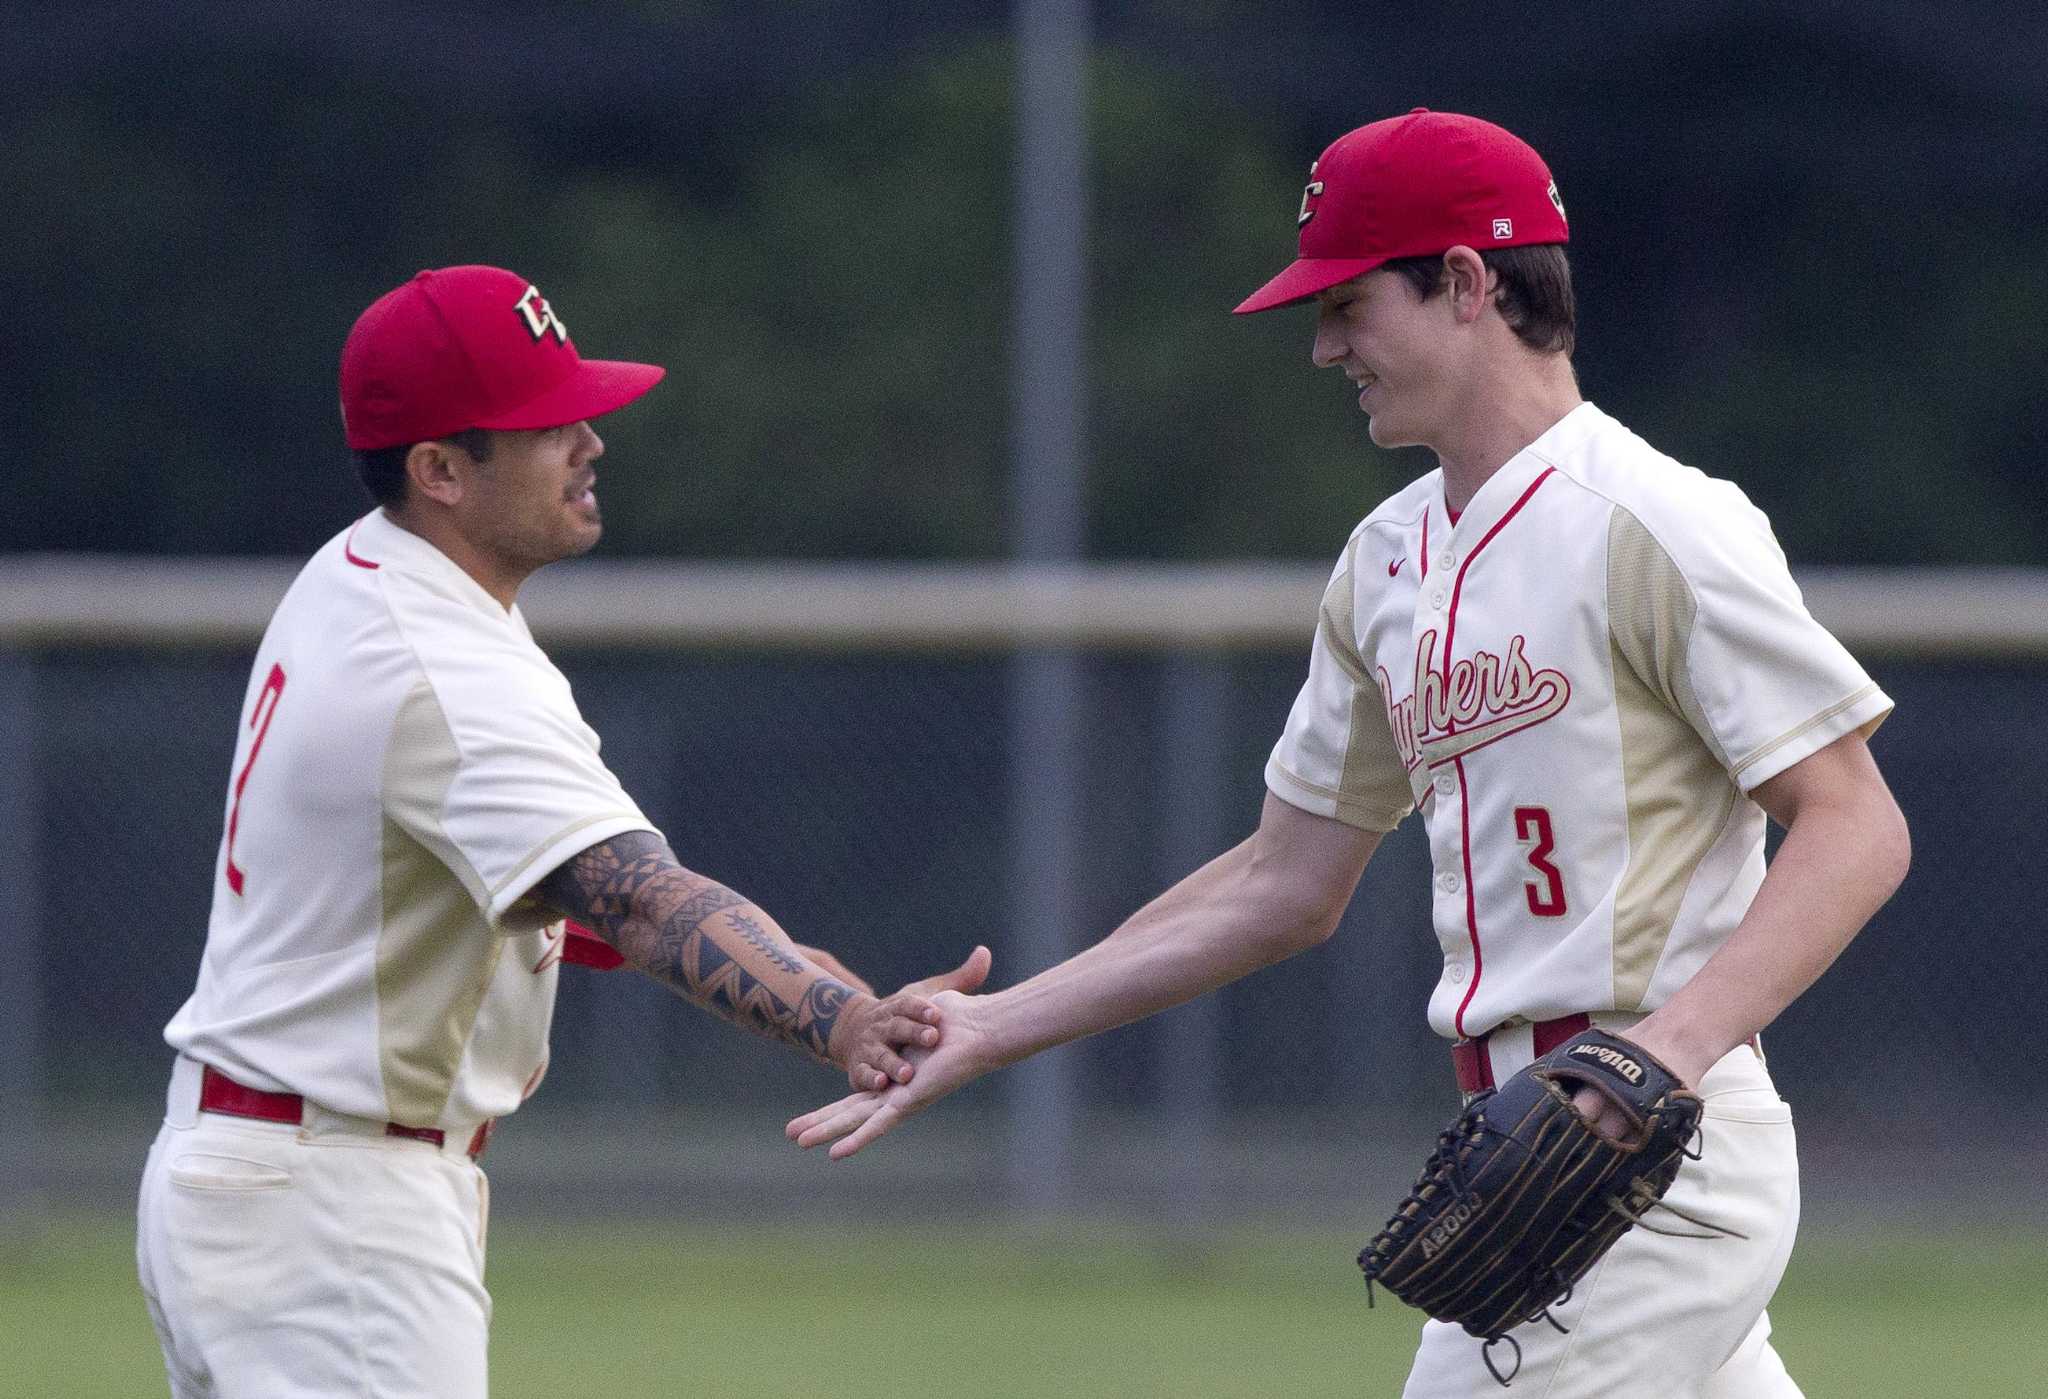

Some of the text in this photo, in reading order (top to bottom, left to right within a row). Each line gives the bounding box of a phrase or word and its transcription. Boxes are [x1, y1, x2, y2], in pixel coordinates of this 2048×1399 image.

[1494, 220, 1511, 237] R
[1513, 806, 1568, 918] 3
[1568, 1044, 1643, 1084] Wilson
